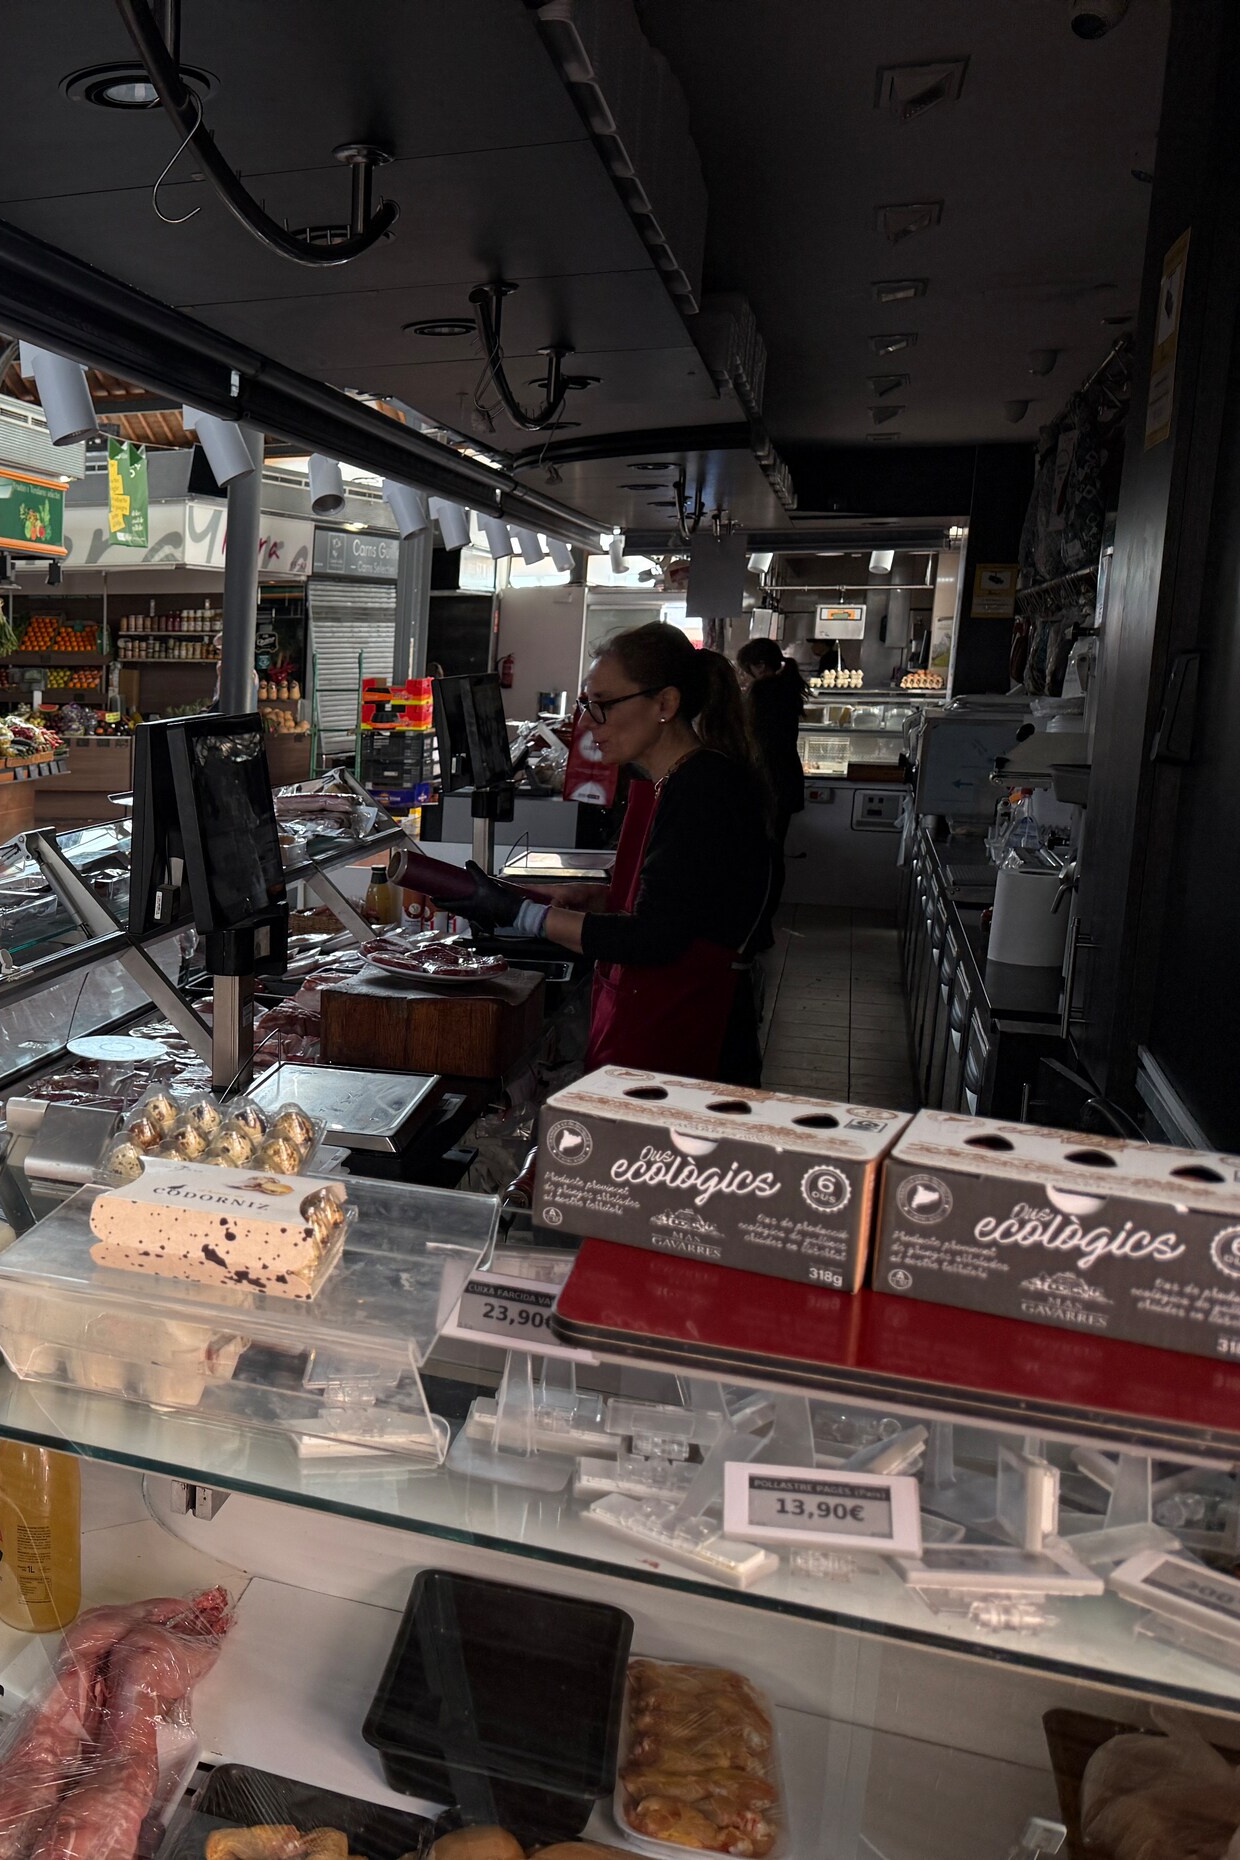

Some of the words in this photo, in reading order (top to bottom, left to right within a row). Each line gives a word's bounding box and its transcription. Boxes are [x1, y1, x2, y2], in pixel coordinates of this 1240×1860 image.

[639, 1145, 675, 1163] Ous
[610, 1156, 782, 1207] ecològics
[817, 1175, 837, 1193] 6
[153, 1186, 271, 1212] CODORNIZ
[811, 1190, 837, 1205] OUS
[1010, 1202, 1056, 1223] Ous
[651, 1235, 723, 1259] GAVARRES
[671, 1230, 702, 1243] MAS
[973, 1215, 1187, 1270] ecològics
[809, 1267, 843, 1287] 318g
[468, 1283, 495, 1296] CUIXA
[497, 1286, 536, 1304] FARCIDA
[1020, 1301, 1108, 1330] GAVARRES
[754, 1478, 815, 1494] POLLASTRE
[816, 1483, 852, 1496] PAGÈS
[776, 1498, 865, 1523] 13,90€
